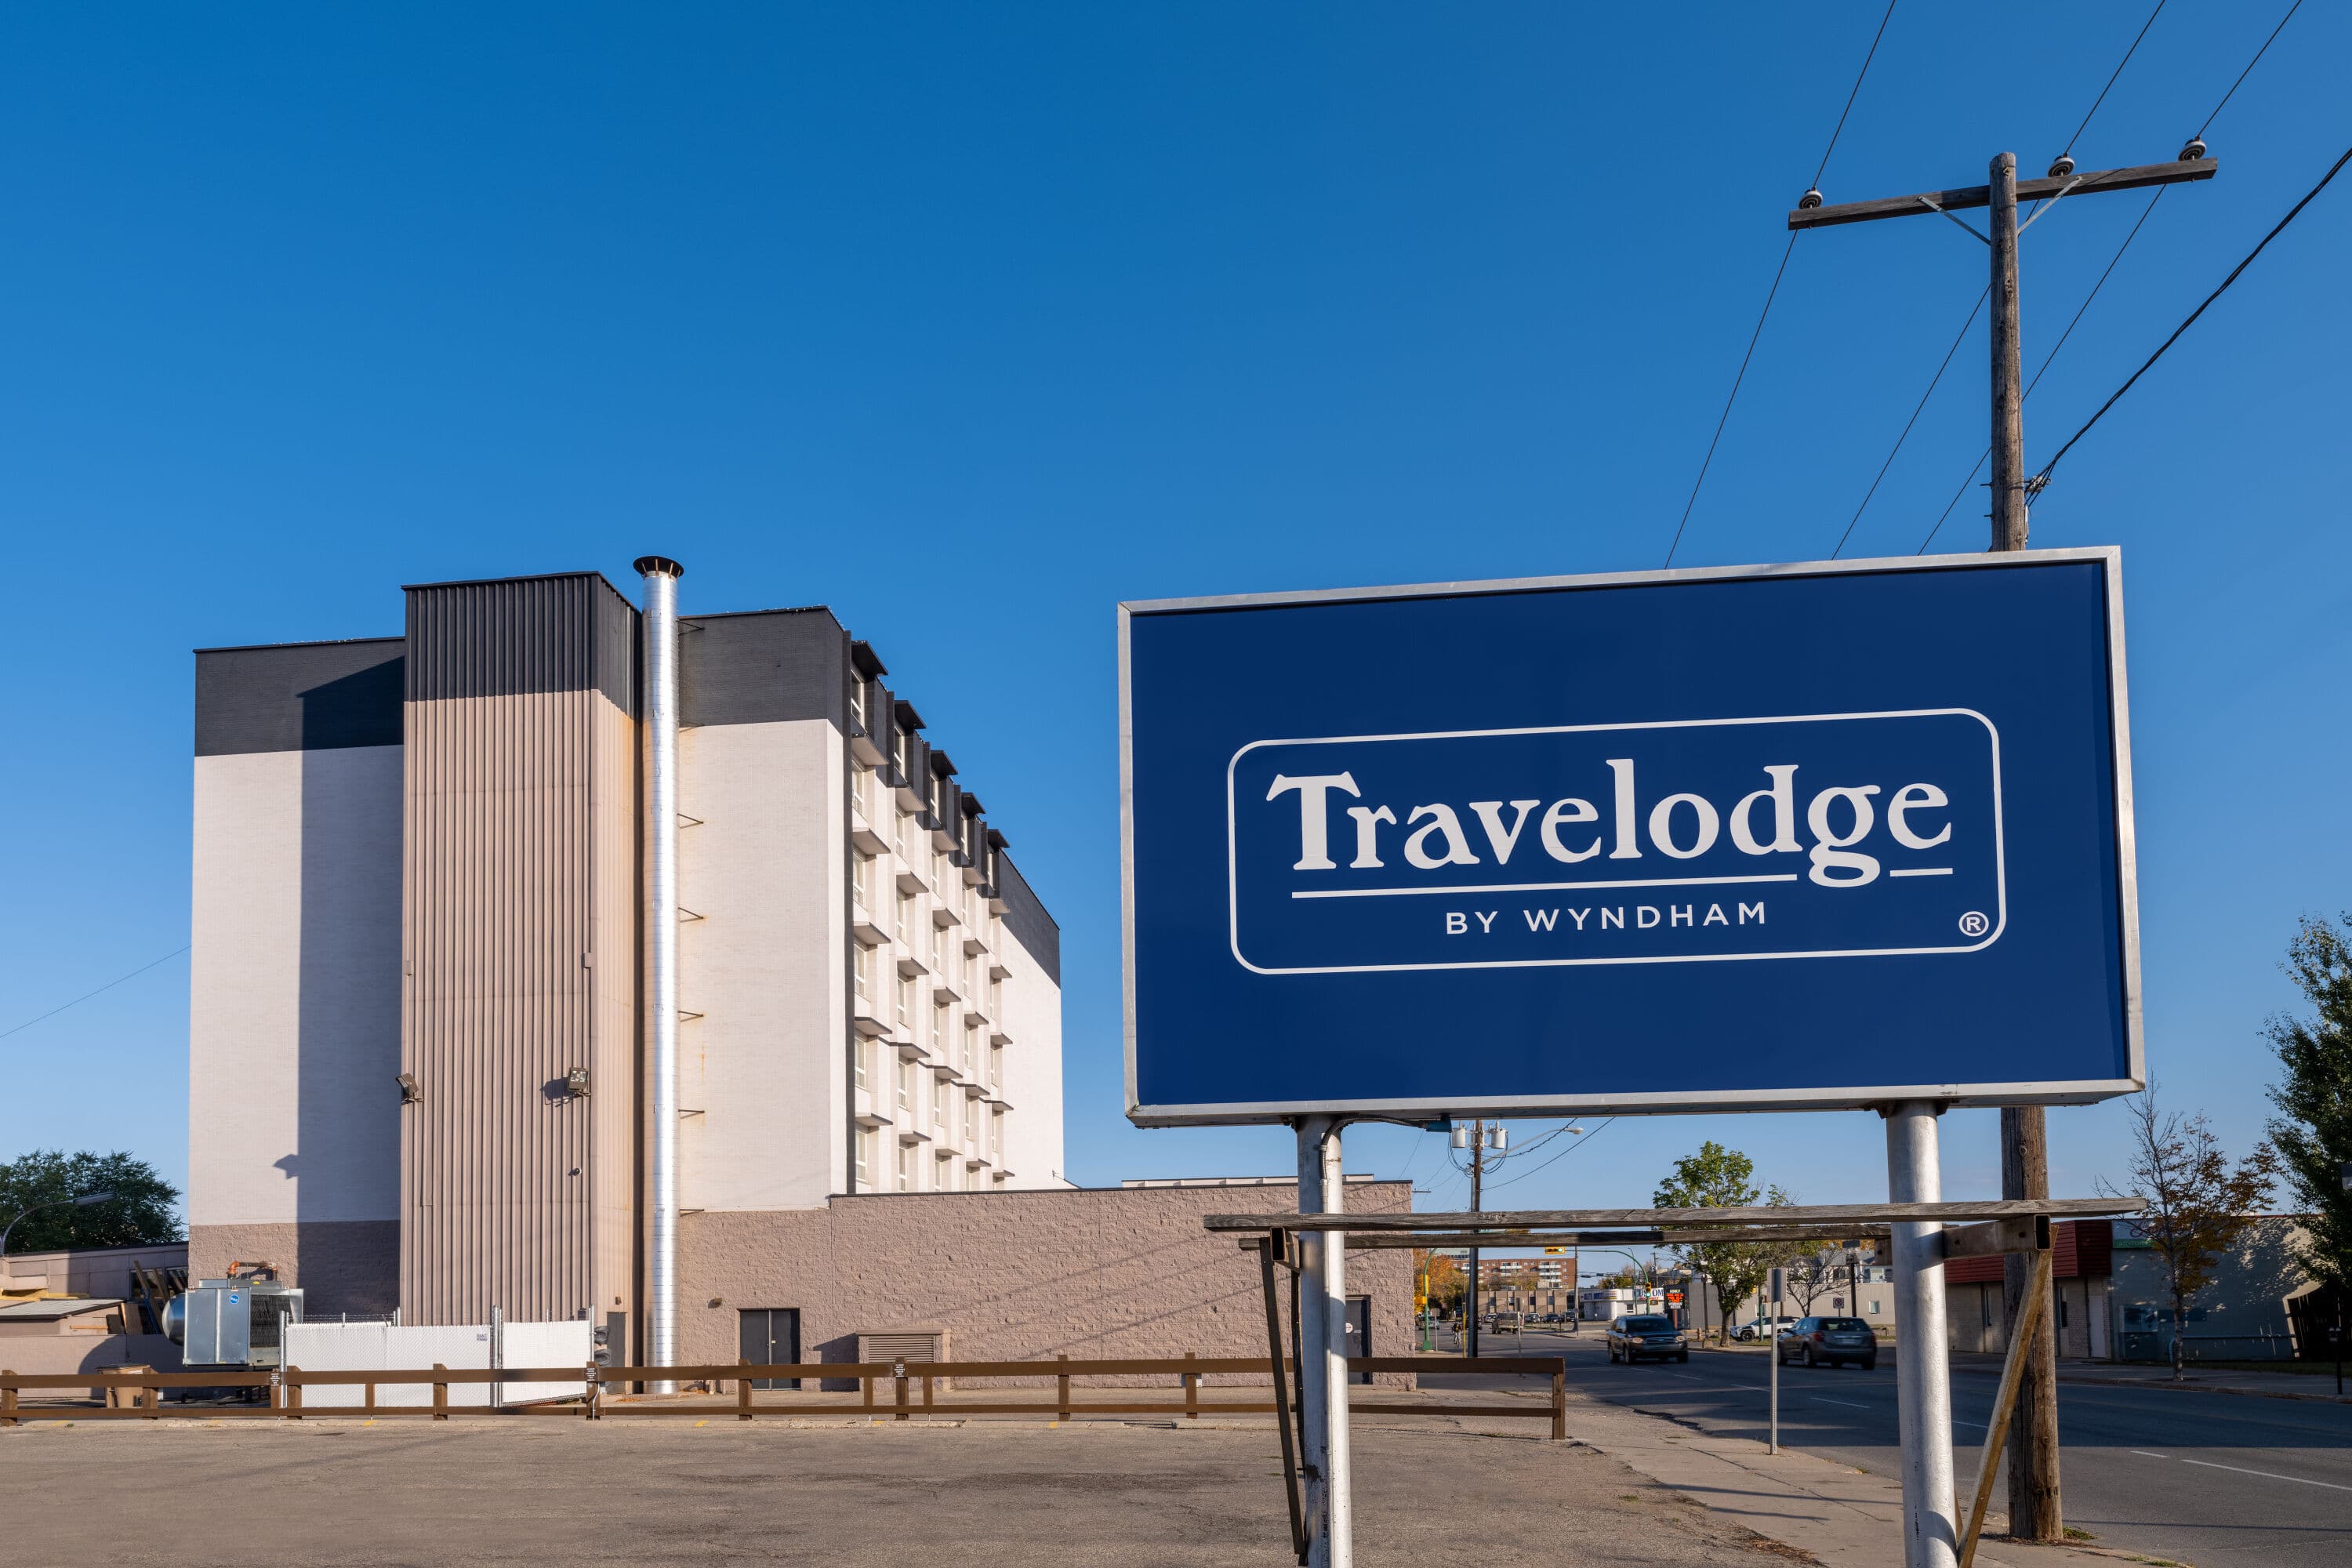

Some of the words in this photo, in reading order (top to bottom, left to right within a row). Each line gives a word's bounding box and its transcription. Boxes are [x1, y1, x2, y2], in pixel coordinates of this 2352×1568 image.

[1265, 758, 1951, 887] Travelodge
[1446, 911, 1498, 935] BY
[1523, 902, 1766, 931] WYNDHAM
